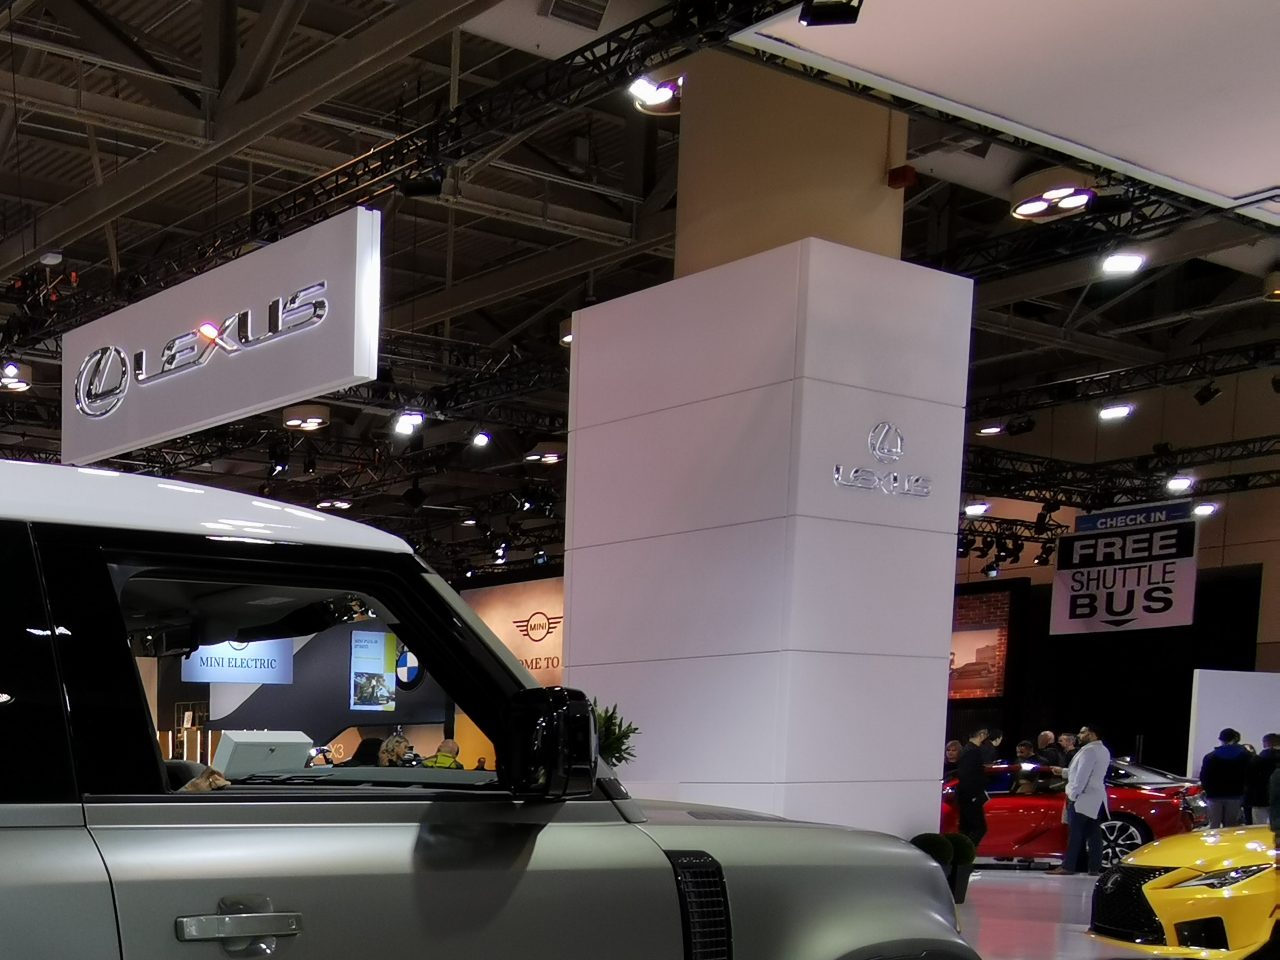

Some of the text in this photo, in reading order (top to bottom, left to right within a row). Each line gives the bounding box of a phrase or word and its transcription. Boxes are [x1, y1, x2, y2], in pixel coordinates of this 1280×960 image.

[133, 280, 329, 386] LEXUS
[833, 464, 931, 497] LEXUS
[1096, 510, 1167, 529] CHECK IN
[1072, 529, 1178, 564] FREE
[1070, 562, 1177, 593] SHUTTLE
[1068, 586, 1174, 620] BUS
[529, 622, 547, 632] MINI
[199, 656, 277, 669] MINI ELECTRIC
[544, 656, 560, 669] TO
